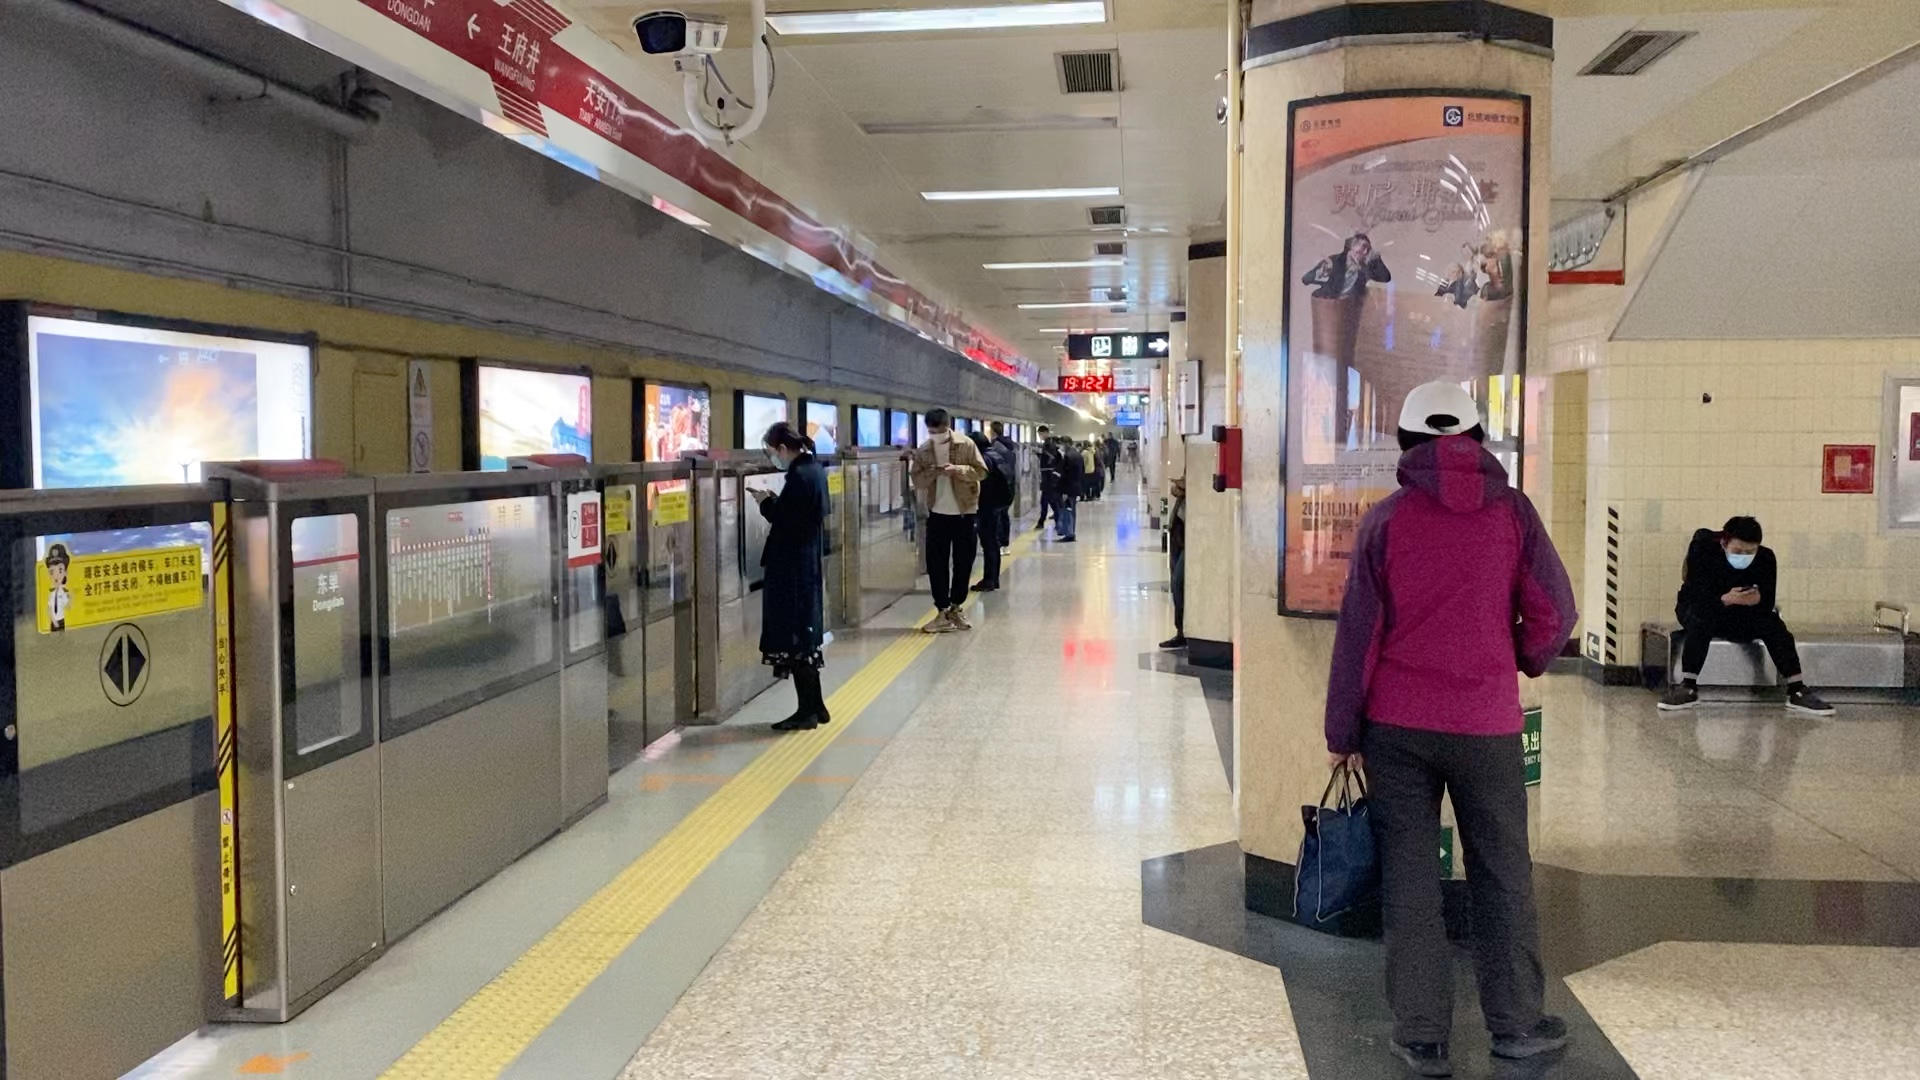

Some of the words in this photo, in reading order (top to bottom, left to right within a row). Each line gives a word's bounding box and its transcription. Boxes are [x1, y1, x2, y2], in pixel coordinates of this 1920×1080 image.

[498, 22, 541, 75] 王府井
[317, 572, 340, 595] 东单
